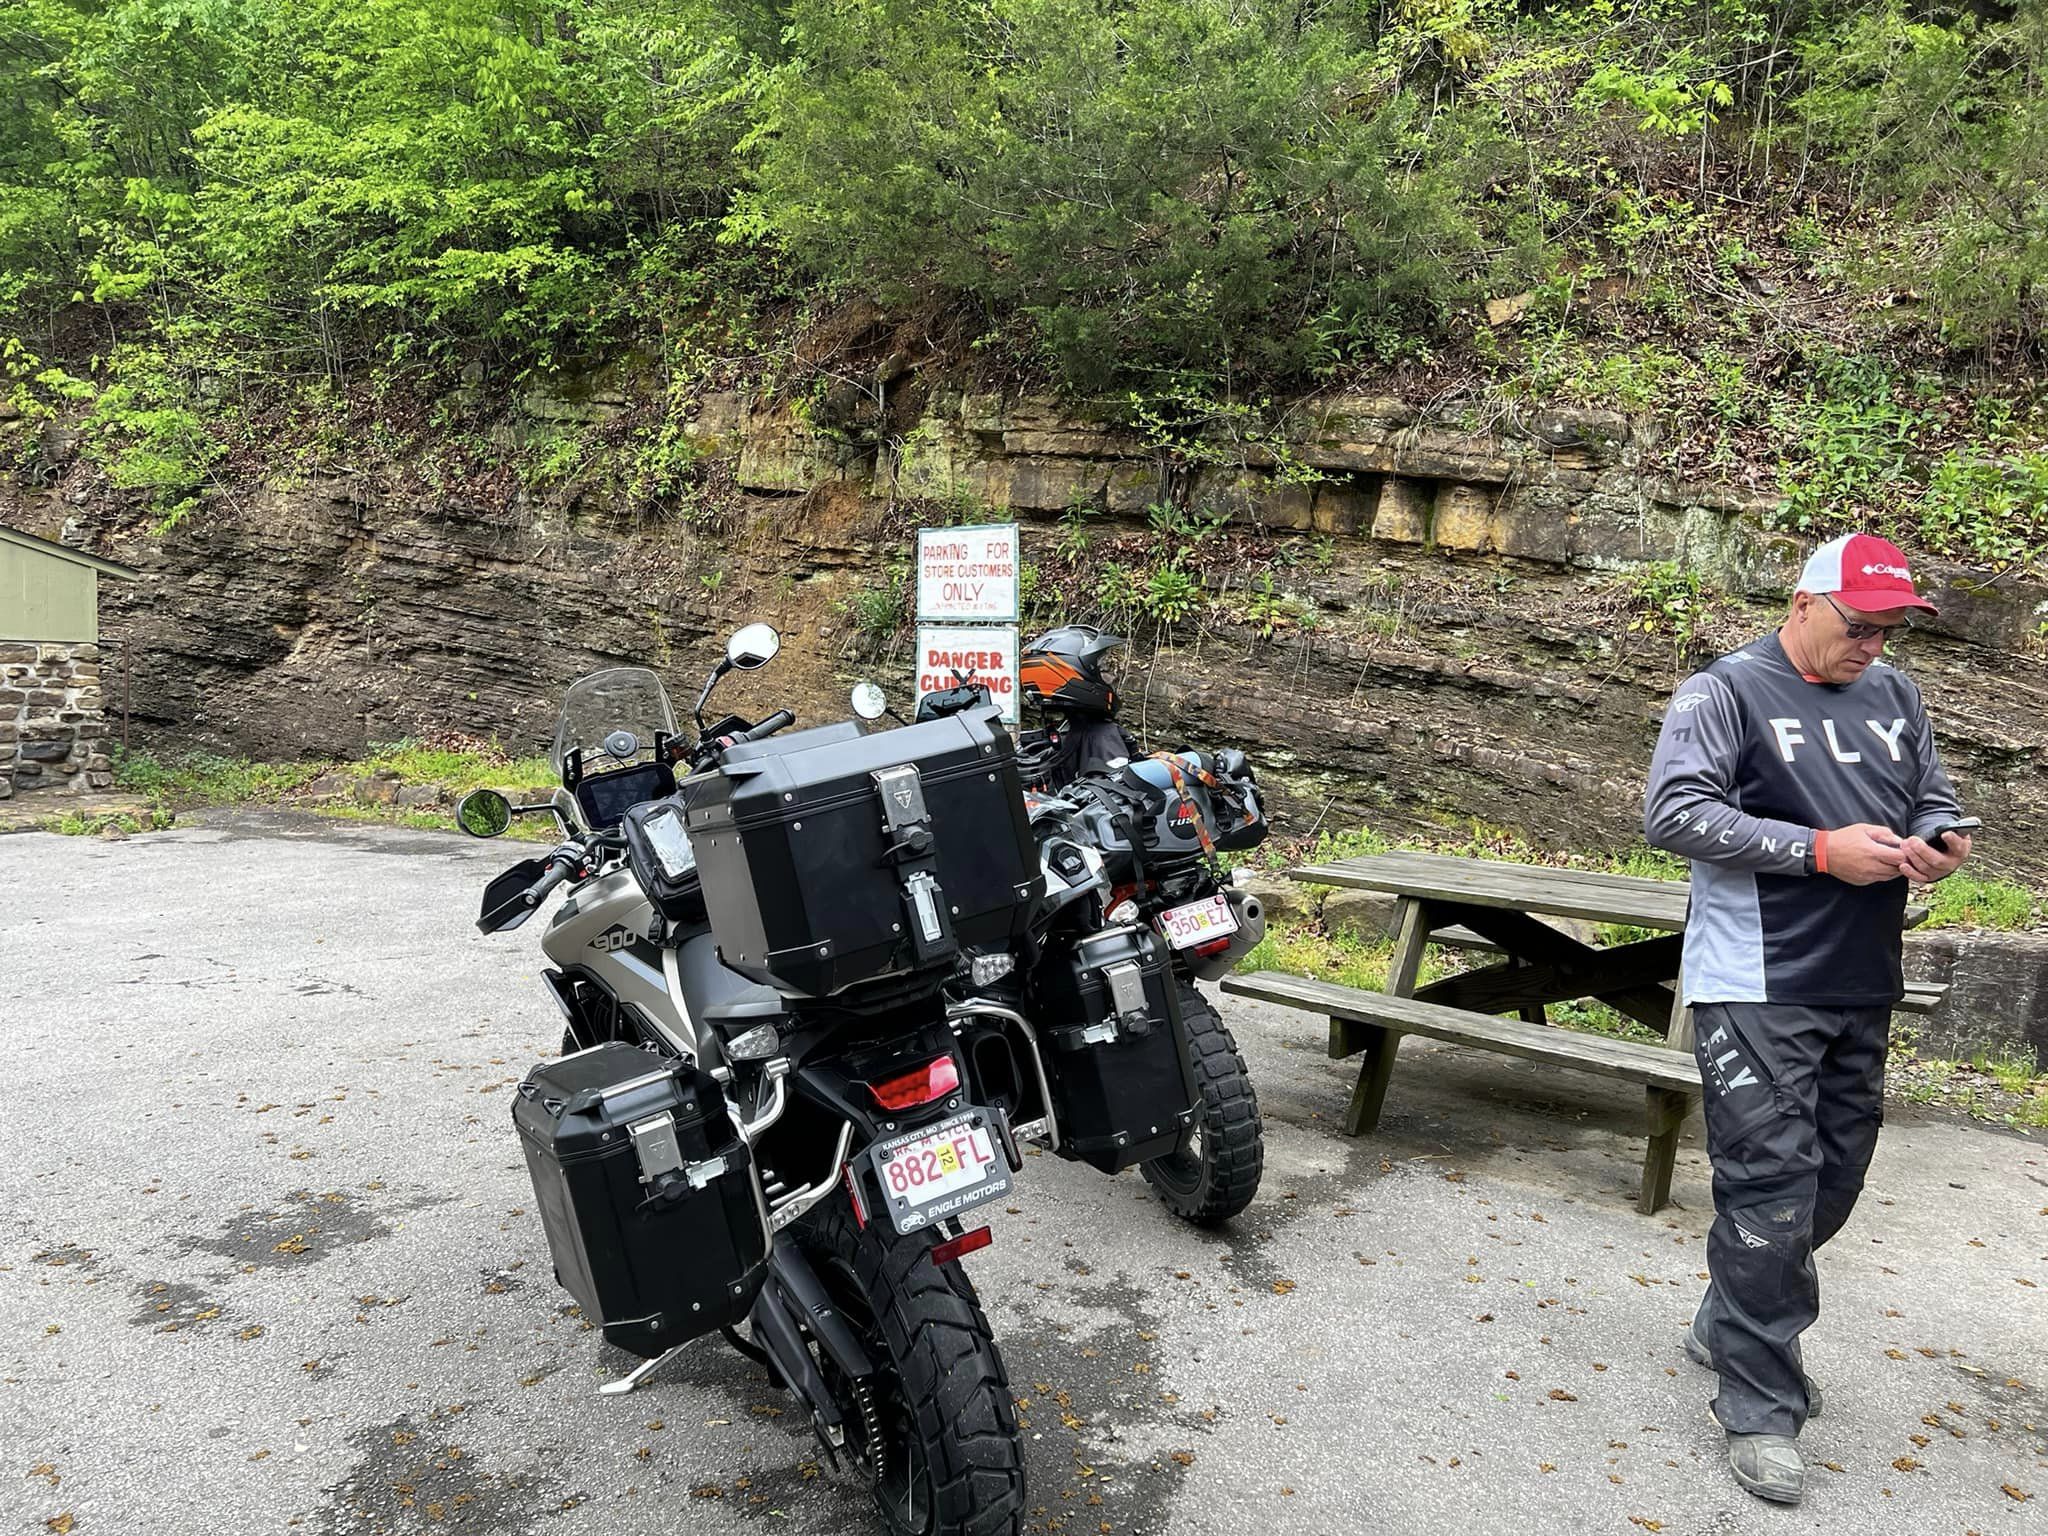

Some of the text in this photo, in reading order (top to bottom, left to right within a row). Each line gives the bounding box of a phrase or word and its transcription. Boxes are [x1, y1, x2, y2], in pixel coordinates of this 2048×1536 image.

[923, 542, 1009, 561] PARKING FOR
[924, 563, 1013, 579] STORE CUSTOMERS
[943, 582, 984, 602] ONLY
[928, 649, 1004, 671] DANGER
[920, 674, 1012, 694] CLIING
[1663, 726, 1692, 776] FL
[1768, 717, 1906, 764] FLY
[1169, 817, 1192, 827] TUS
[1672, 809, 1807, 858] RACNG
[1171, 906, 1229, 937] 350 EZ
[593, 930, 638, 952] 900
[1710, 1025, 1760, 1090] FLY
[882, 1136, 910, 1151] KANSAS
[888, 1134, 991, 1193] 882 FL
[940, 1148, 954, 1166] 12
[928, 1179, 1007, 1218] ENGLE MOTORS
